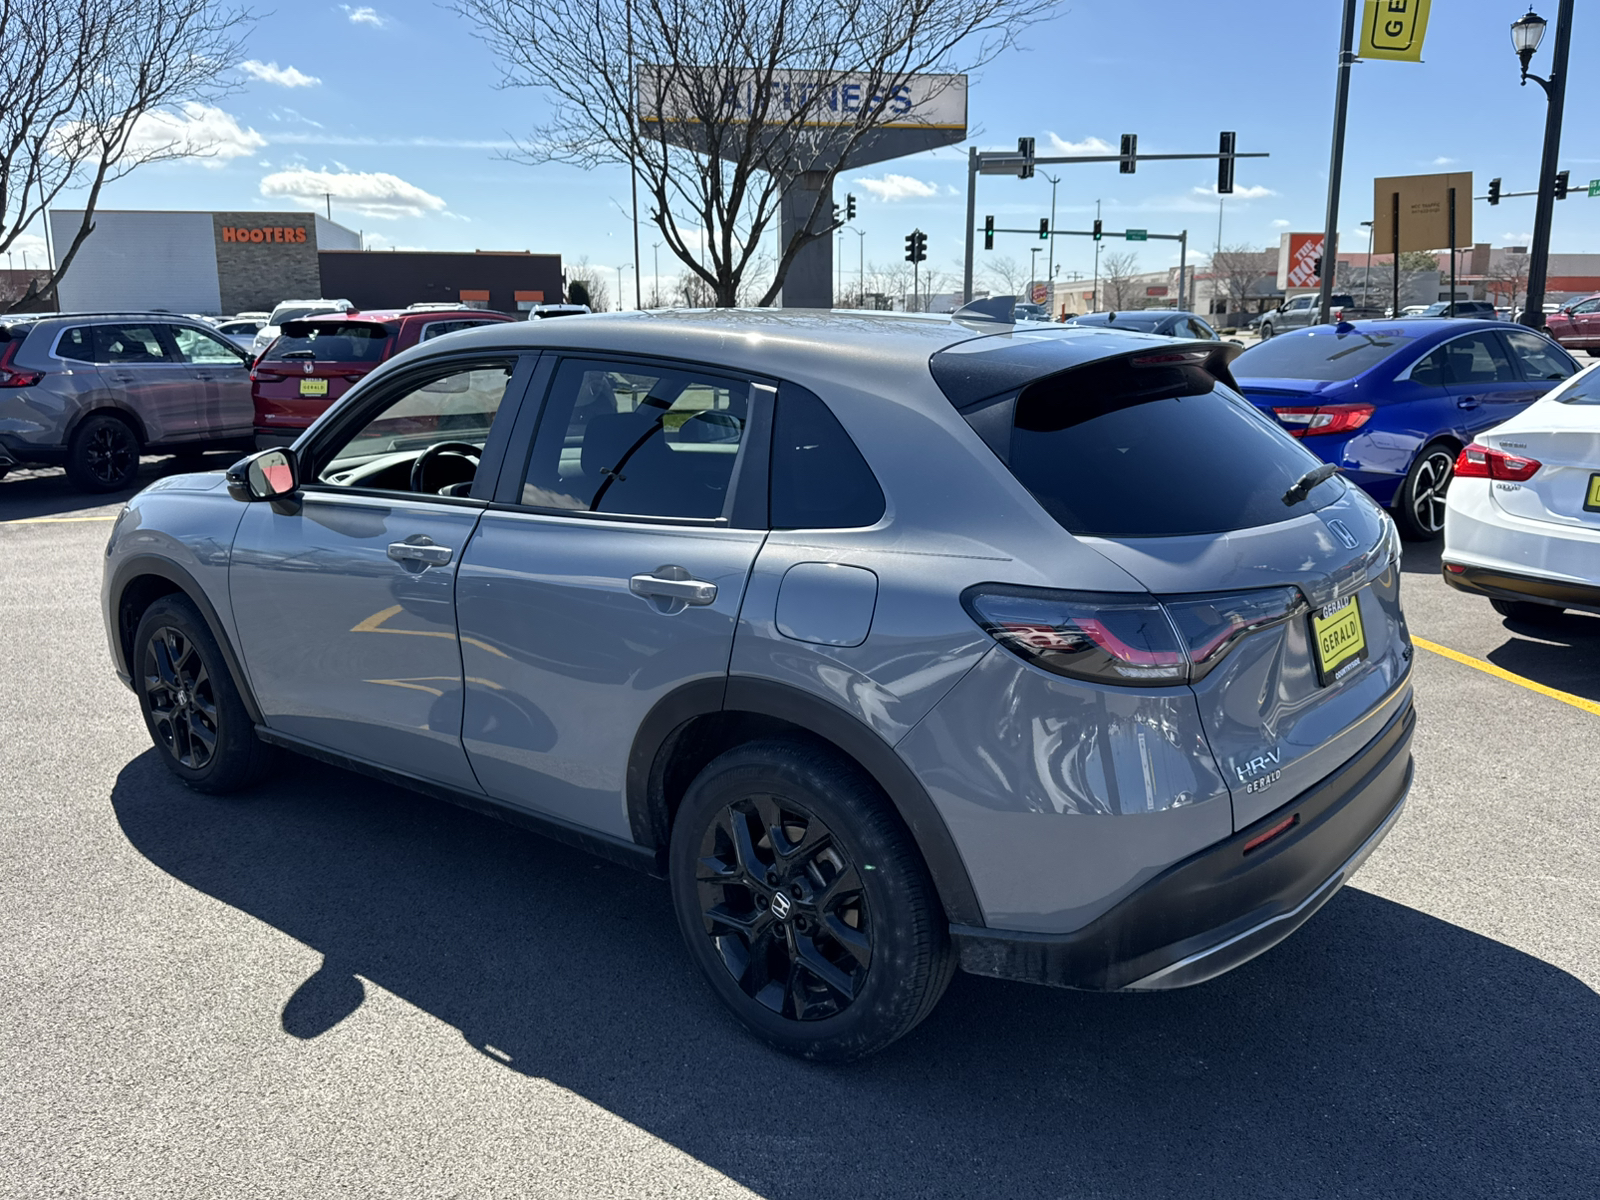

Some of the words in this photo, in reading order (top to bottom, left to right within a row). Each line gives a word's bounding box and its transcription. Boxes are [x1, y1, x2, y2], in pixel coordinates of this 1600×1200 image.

[1385, 0, 1407, 37] GE
[222, 226, 307, 243] HOOTERS
[1288, 238, 1325, 287] HOM
[1293, 239, 1315, 261] THE
[1322, 596, 1349, 618] GERALD
[1323, 621, 1356, 654] GERALD
[1236, 747, 1280, 781] HR-V
[1247, 769, 1281, 794] GERALD
